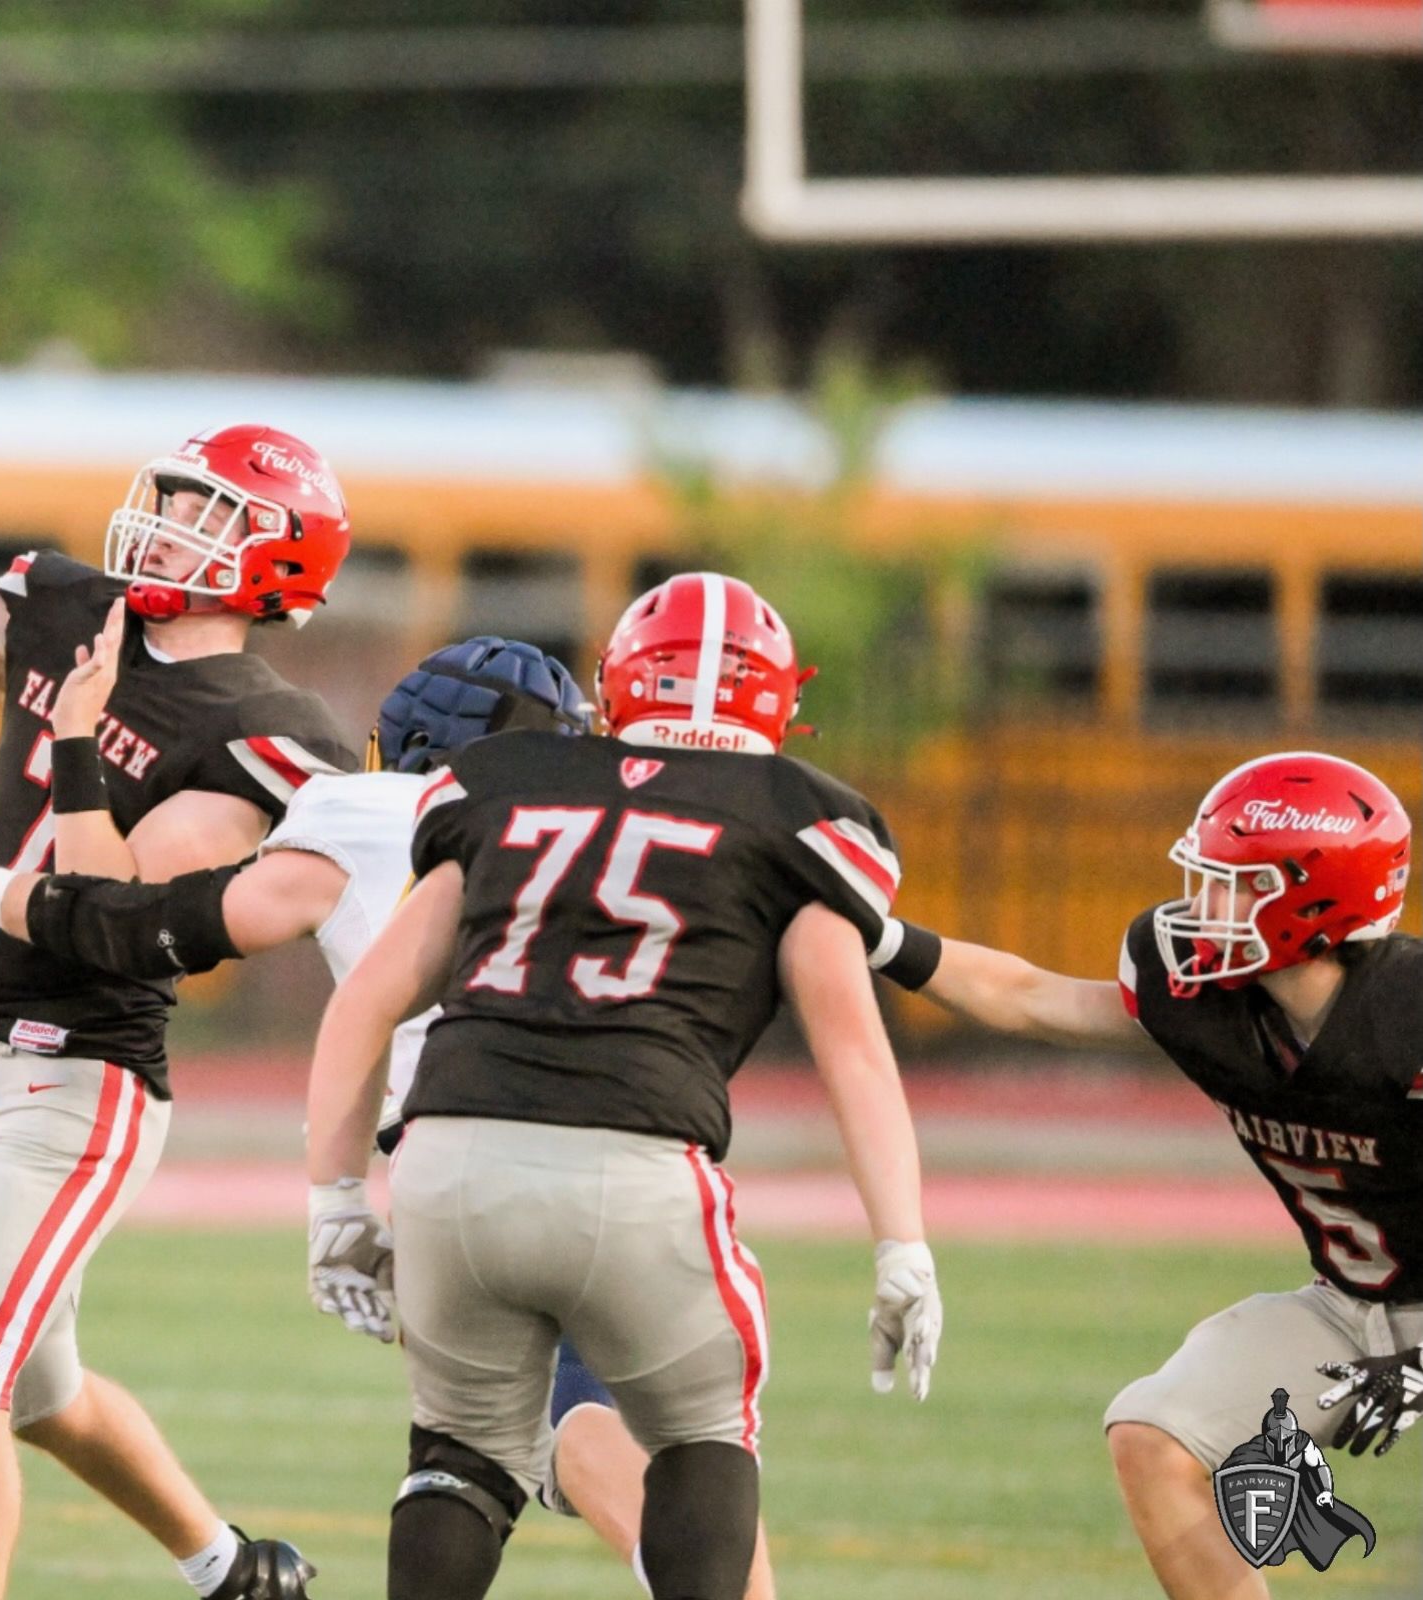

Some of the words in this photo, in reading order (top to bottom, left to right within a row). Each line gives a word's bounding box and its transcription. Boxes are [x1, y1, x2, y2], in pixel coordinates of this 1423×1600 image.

[18, 667, 162, 783] FAIEW
[653, 725, 746, 752] Riddell
[1243, 799, 1356, 834] Fairview
[464, 804, 725, 1001] 75
[1260, 1149, 1405, 1290] 5
